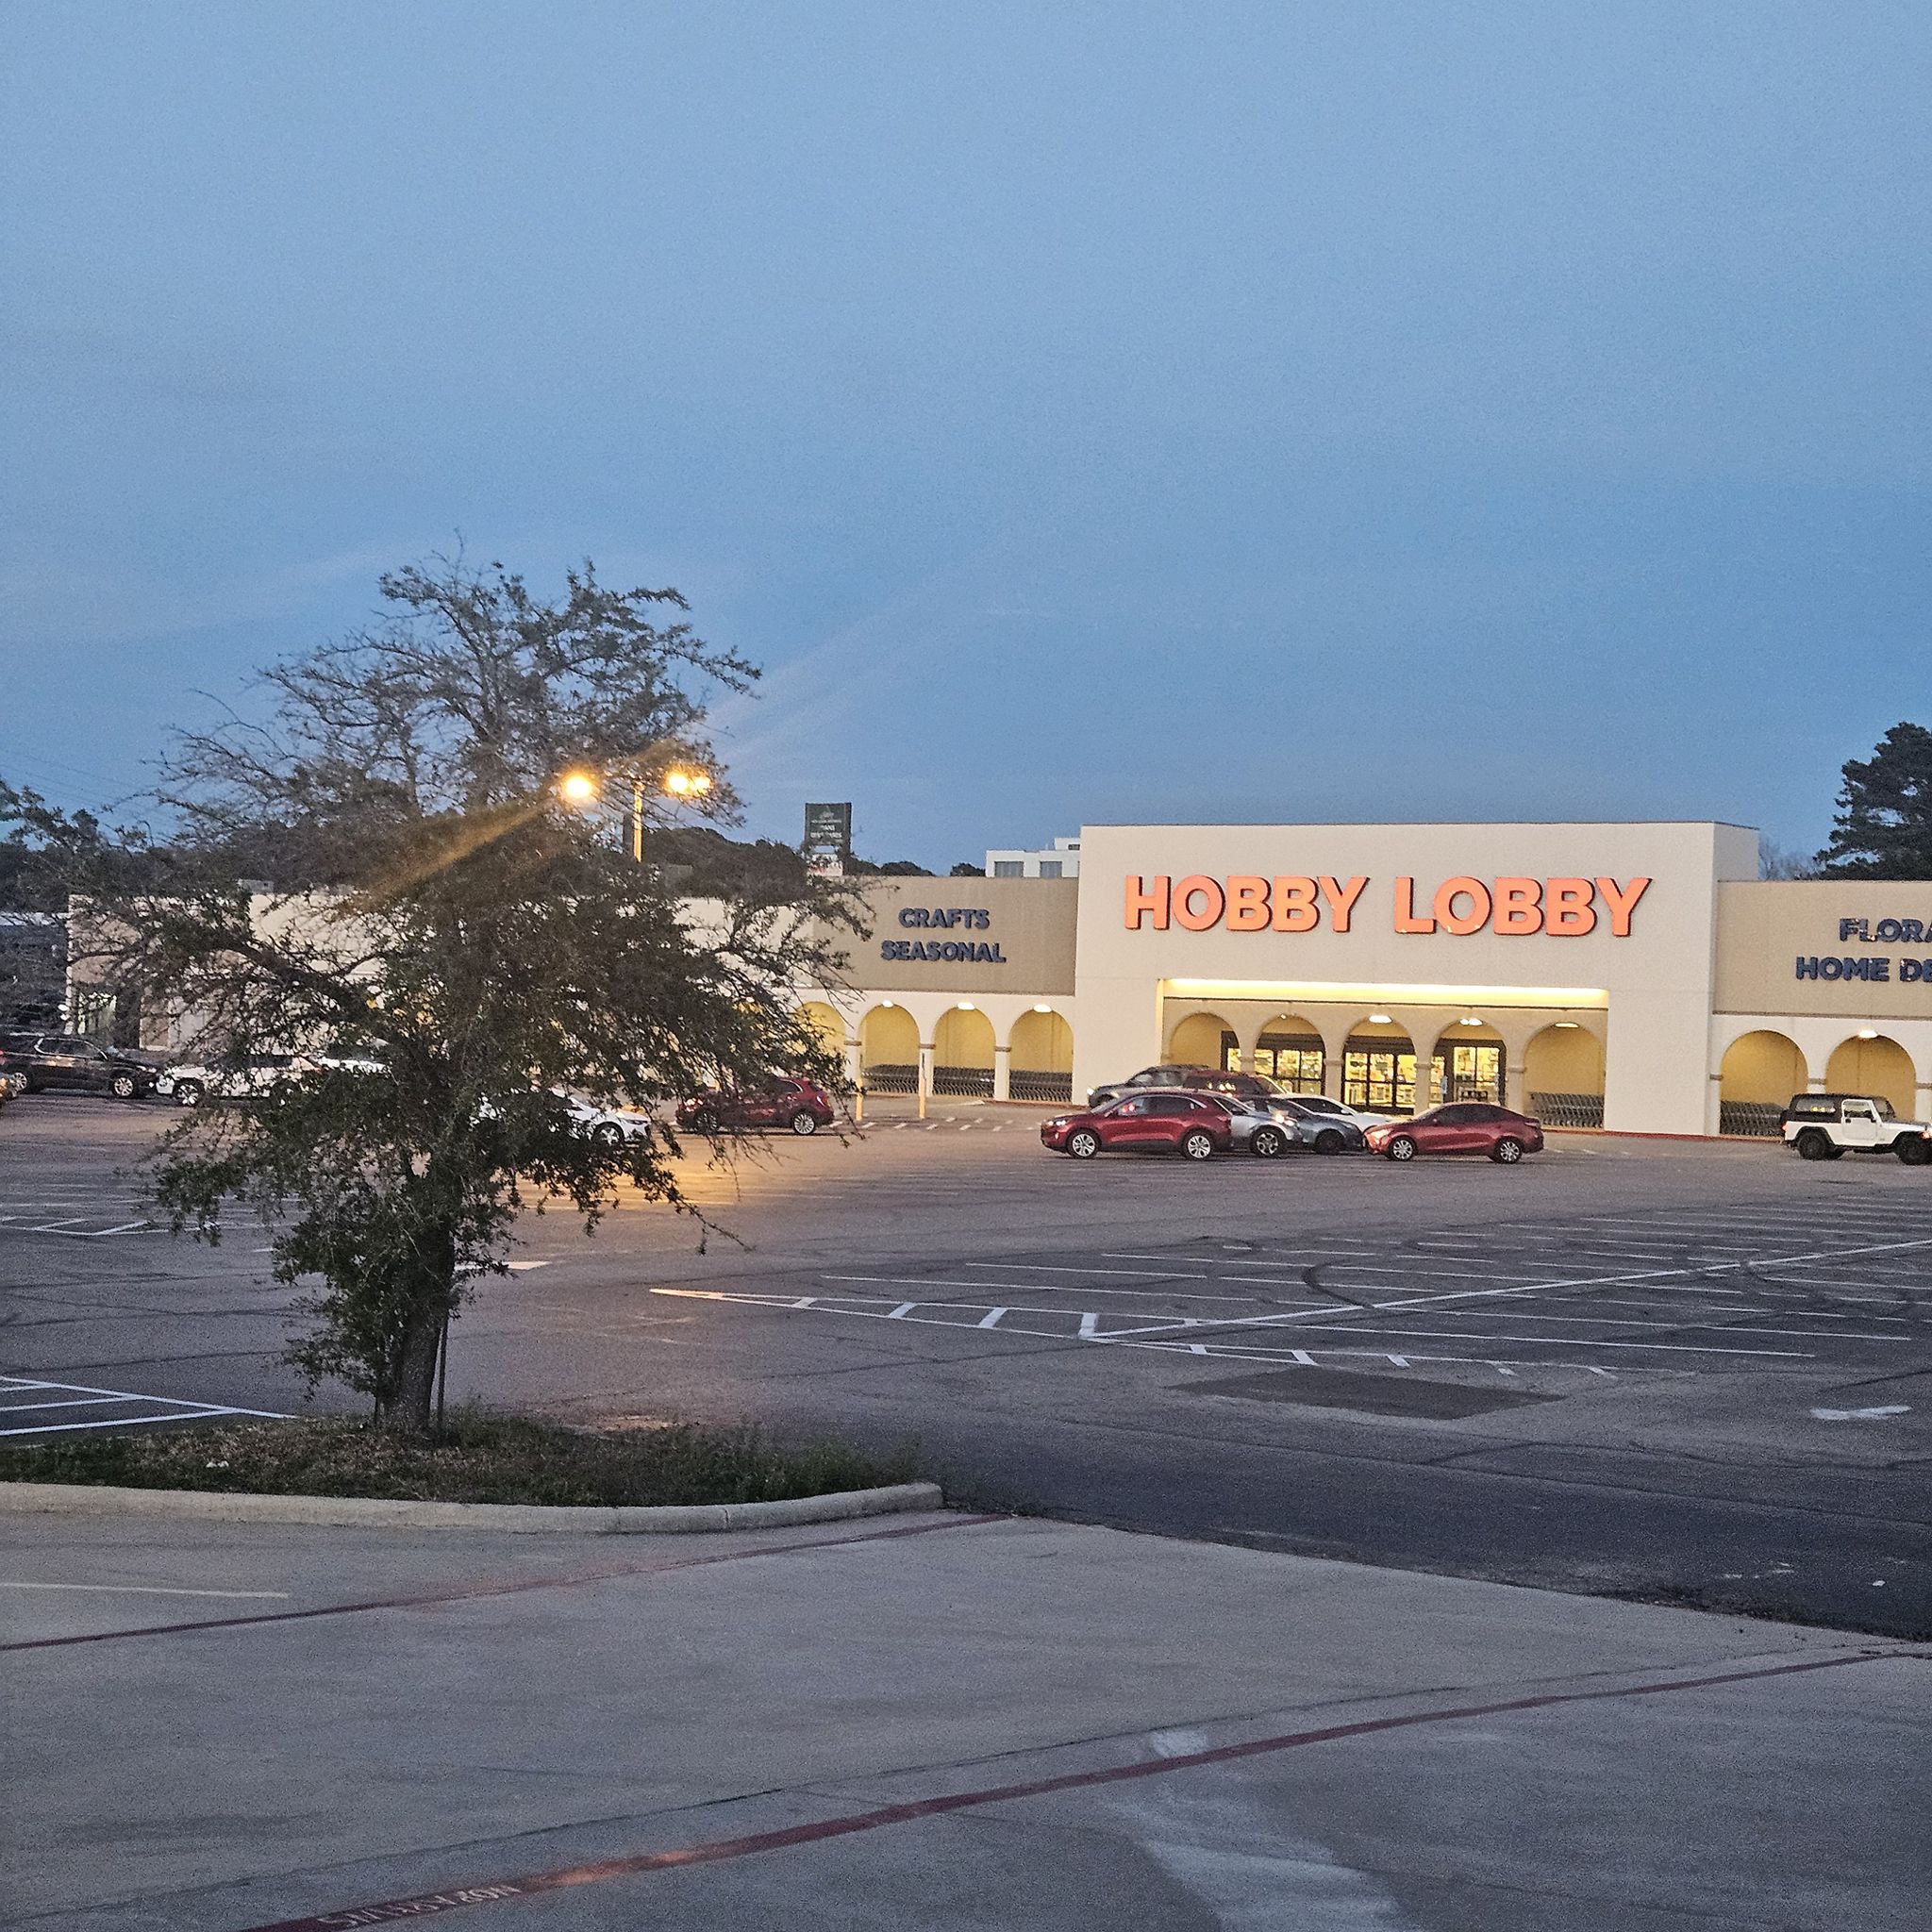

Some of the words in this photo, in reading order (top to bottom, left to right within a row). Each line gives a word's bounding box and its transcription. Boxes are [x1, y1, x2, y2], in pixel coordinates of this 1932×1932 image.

[1124, 874, 1370, 933] HOBBY
[1394, 875, 1653, 937] LOBBY
[898, 908, 991, 929] CRAFTS
[881, 940, 1007, 963] SEASONAL
[1795, 957, 1890, 982] HOME
